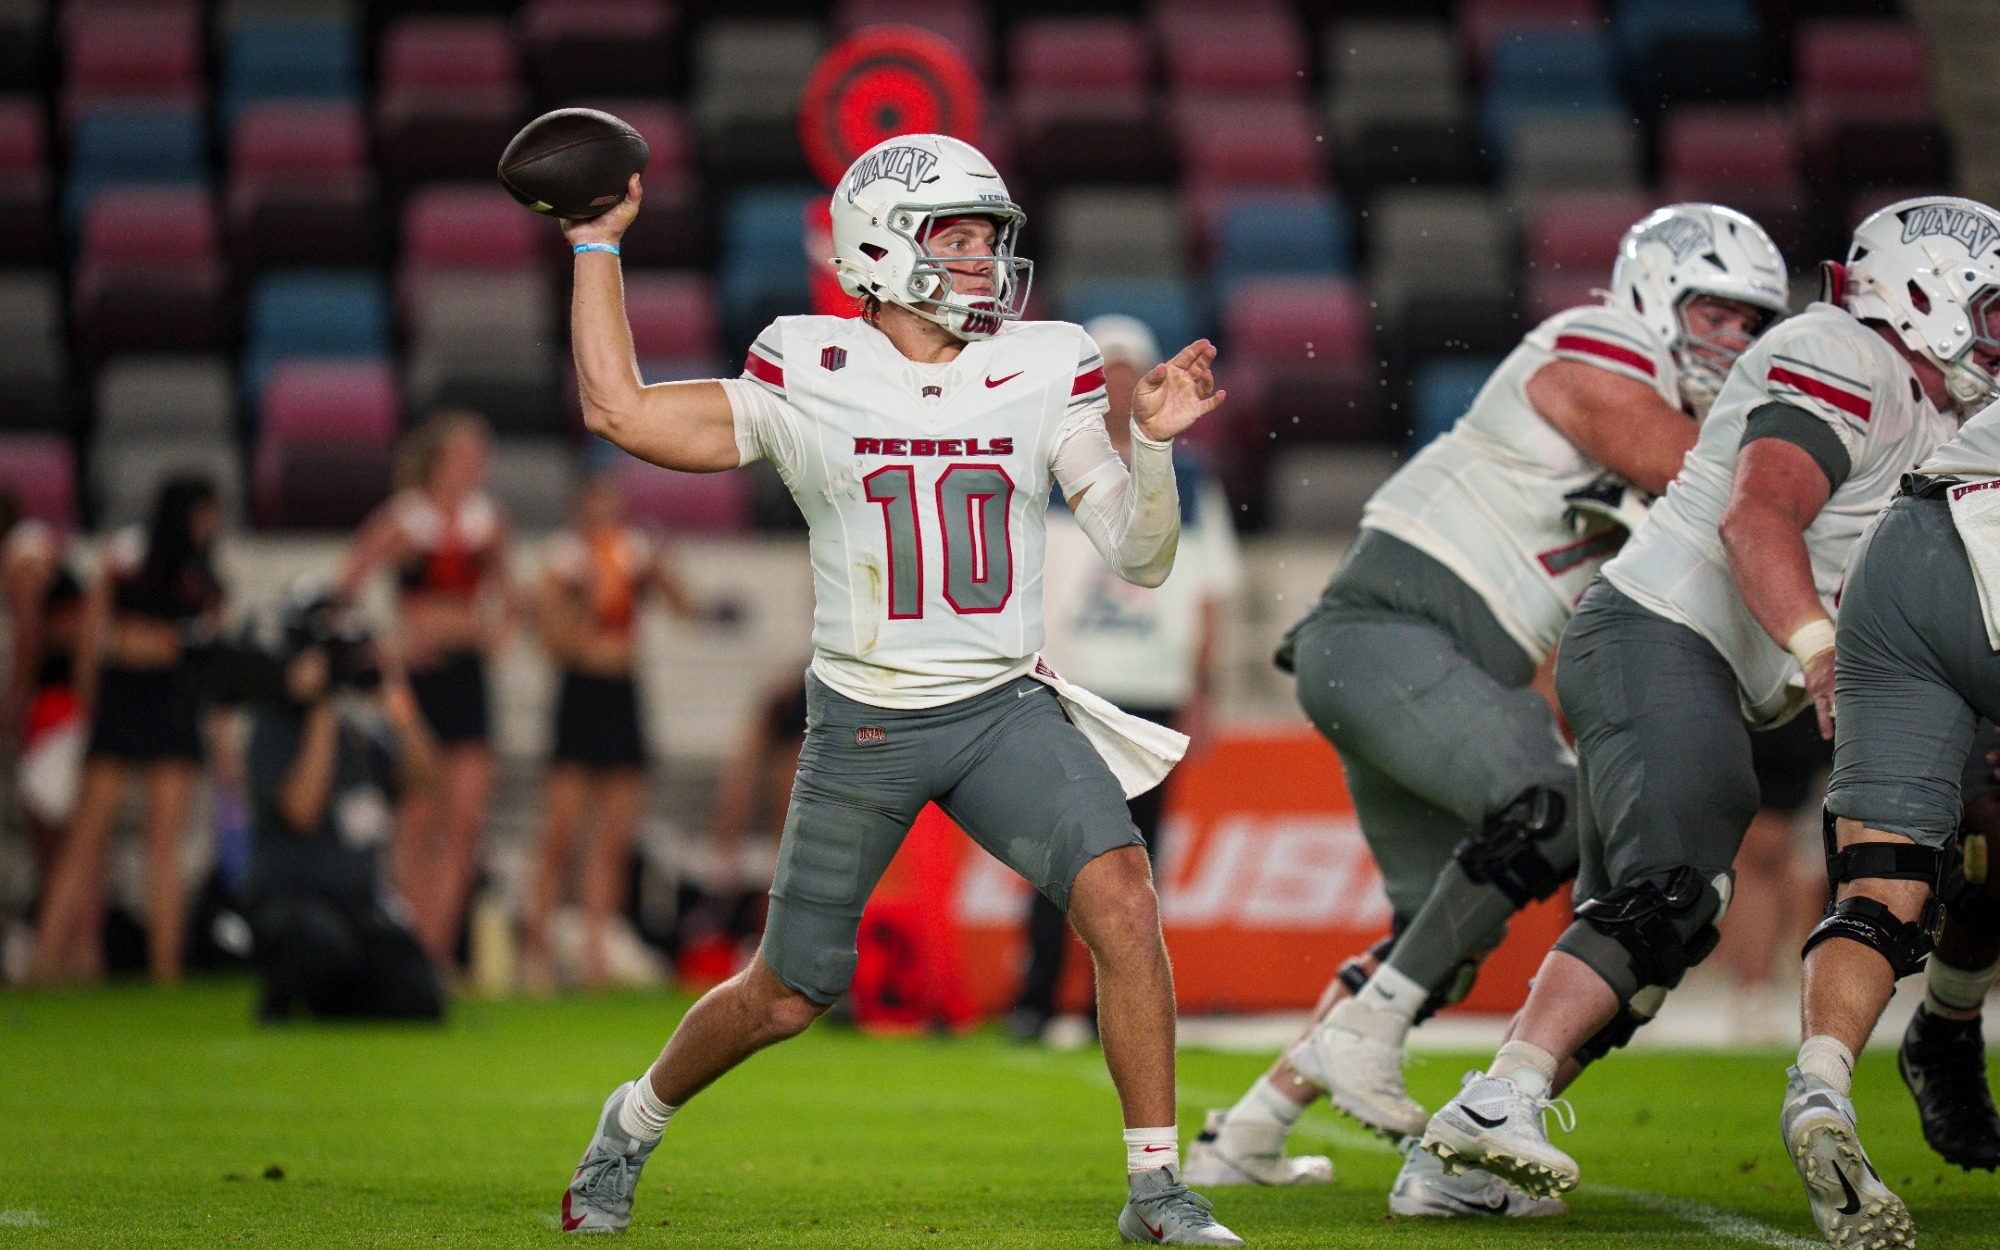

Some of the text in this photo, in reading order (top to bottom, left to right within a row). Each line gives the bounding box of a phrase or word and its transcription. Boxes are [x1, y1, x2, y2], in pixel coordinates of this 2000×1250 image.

[848, 147, 938, 204] UNLV
[1901, 206, 1999, 260] UNLV
[853, 437, 1014, 457] REBELS
[862, 463, 1016, 621] 10
[856, 727, 886, 744] UNLV
